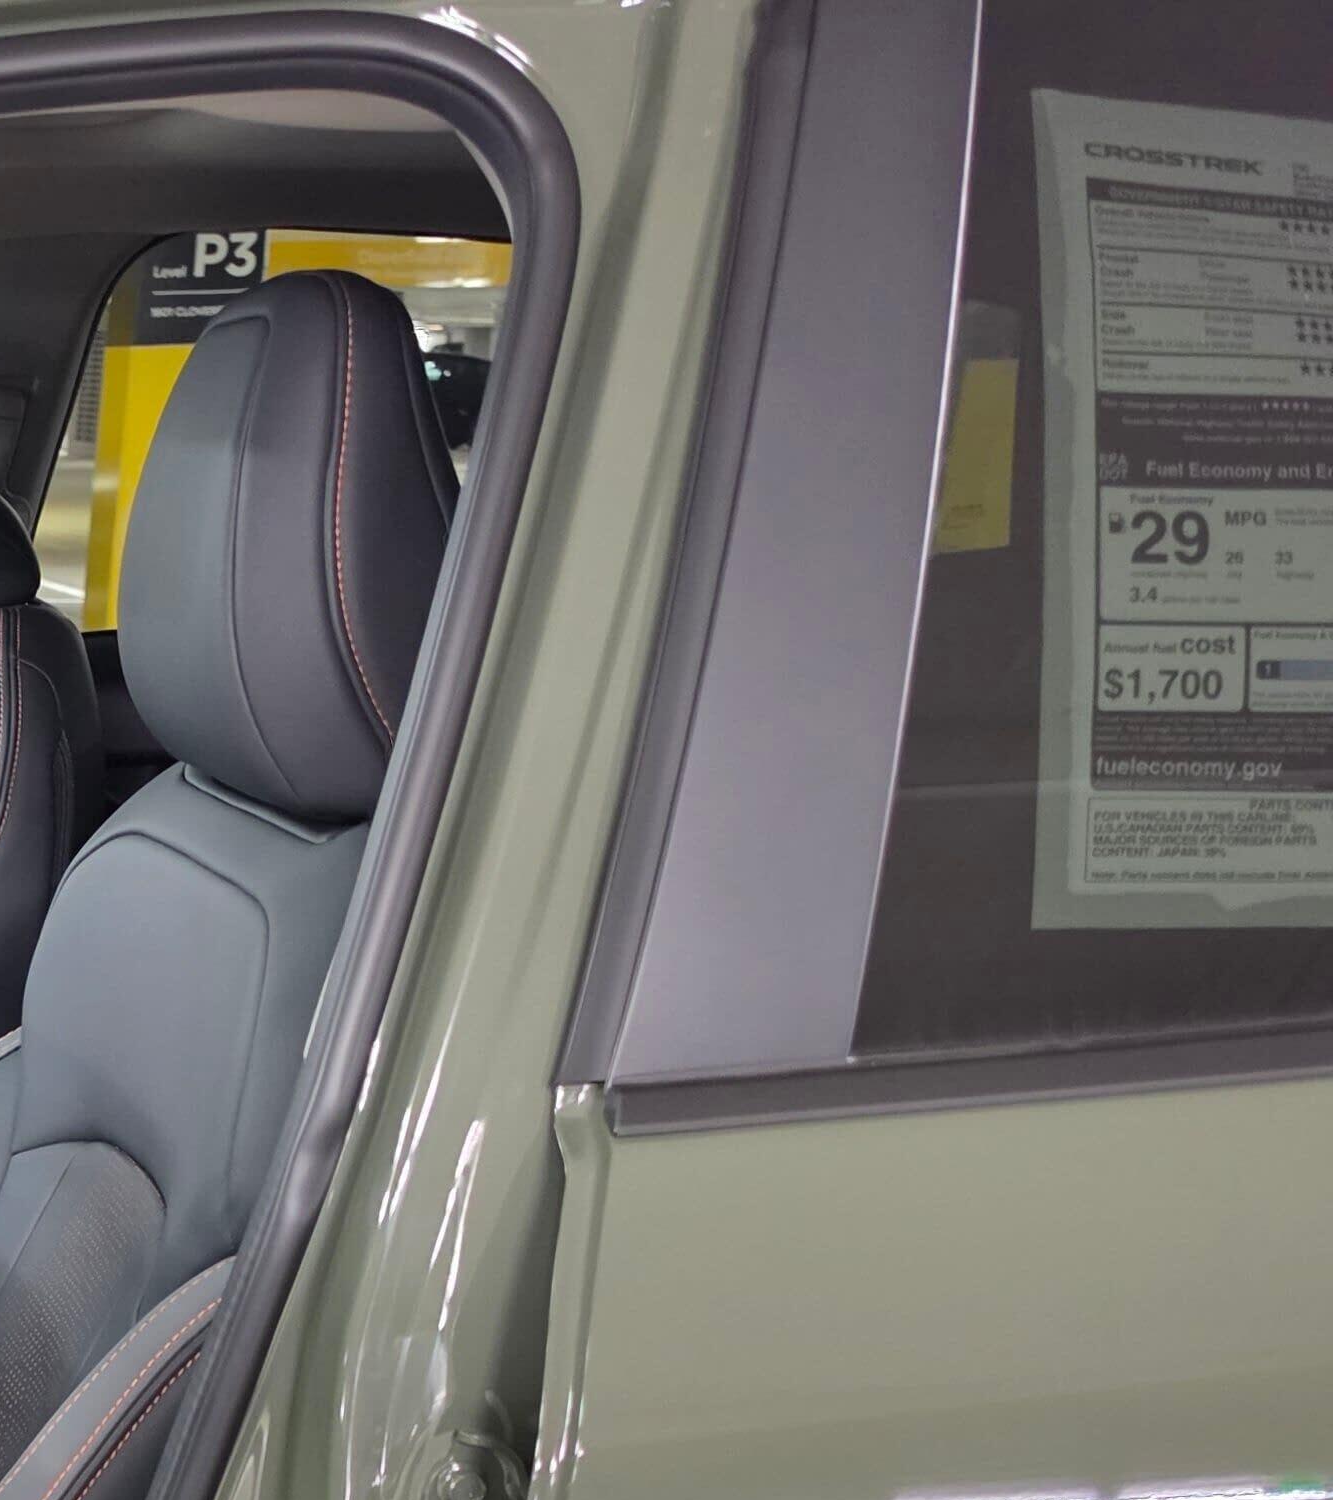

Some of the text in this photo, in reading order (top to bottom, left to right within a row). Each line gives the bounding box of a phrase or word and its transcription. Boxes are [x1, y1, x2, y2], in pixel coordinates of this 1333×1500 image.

[1085, 142, 1263, 175] CROSSTREK
[193, 232, 258, 278] P3
[1145, 460, 1183, 478] Fuel
[1189, 461, 1271, 481] Economy
[1278, 462, 1311, 479] and
[1131, 510, 1266, 565] 29 MPG
[1129, 586, 1158, 603] 3.4
[1180, 635, 1236, 655] cost
[1104, 668, 1223, 703] $1,700
[1096, 756, 1283, 781] fueleconomy.gov
